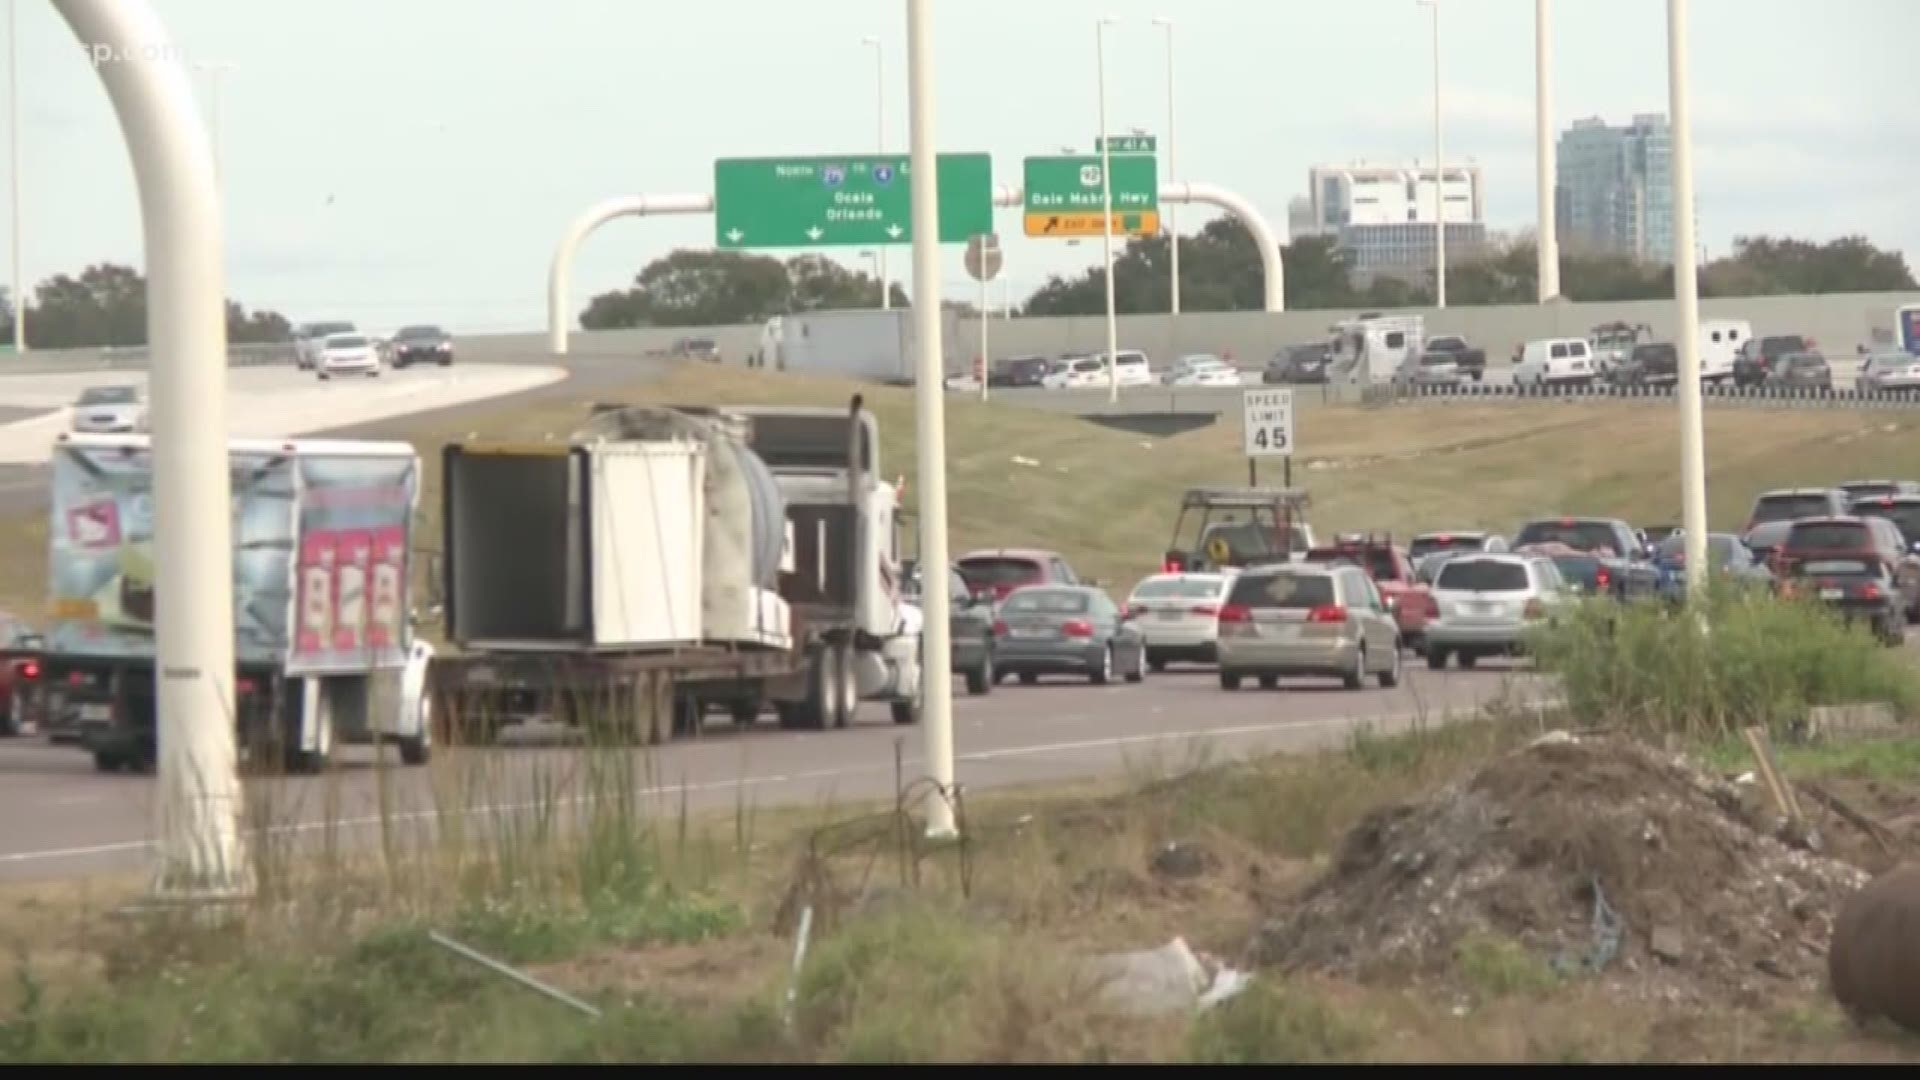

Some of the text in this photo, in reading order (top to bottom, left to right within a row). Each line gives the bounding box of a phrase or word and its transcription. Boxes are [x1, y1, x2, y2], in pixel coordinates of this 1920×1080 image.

[834, 191, 874, 204] Ocala
[1031, 192, 1064, 204] Dale
[1119, 192, 1149, 205] Hwy
[826, 207, 883, 220] Orlando
[1247, 394, 1289, 406] SPEED
[1251, 409, 1285, 422] LIMIT
[1254, 426, 1287, 449] 45
